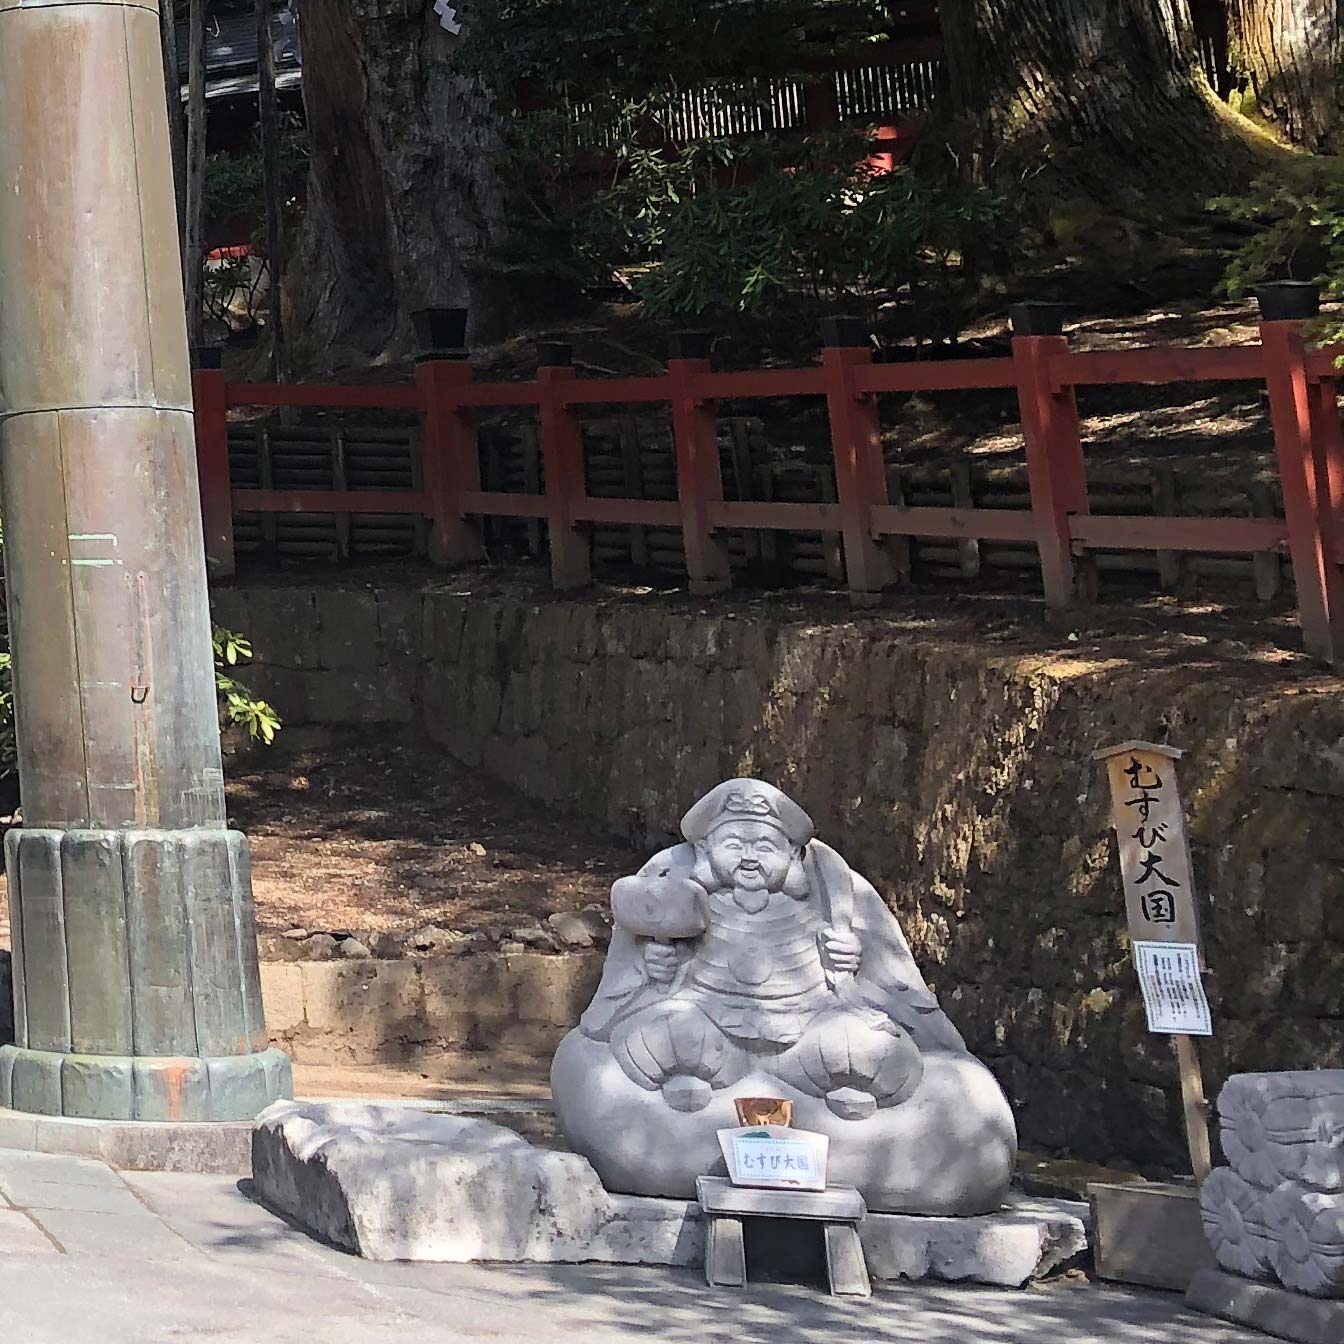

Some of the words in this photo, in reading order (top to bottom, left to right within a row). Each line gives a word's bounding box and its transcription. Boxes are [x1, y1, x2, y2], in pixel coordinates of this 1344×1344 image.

[1123, 757, 1180, 924] むすび大国
[743, 1152, 809, 1171] むすび大国
